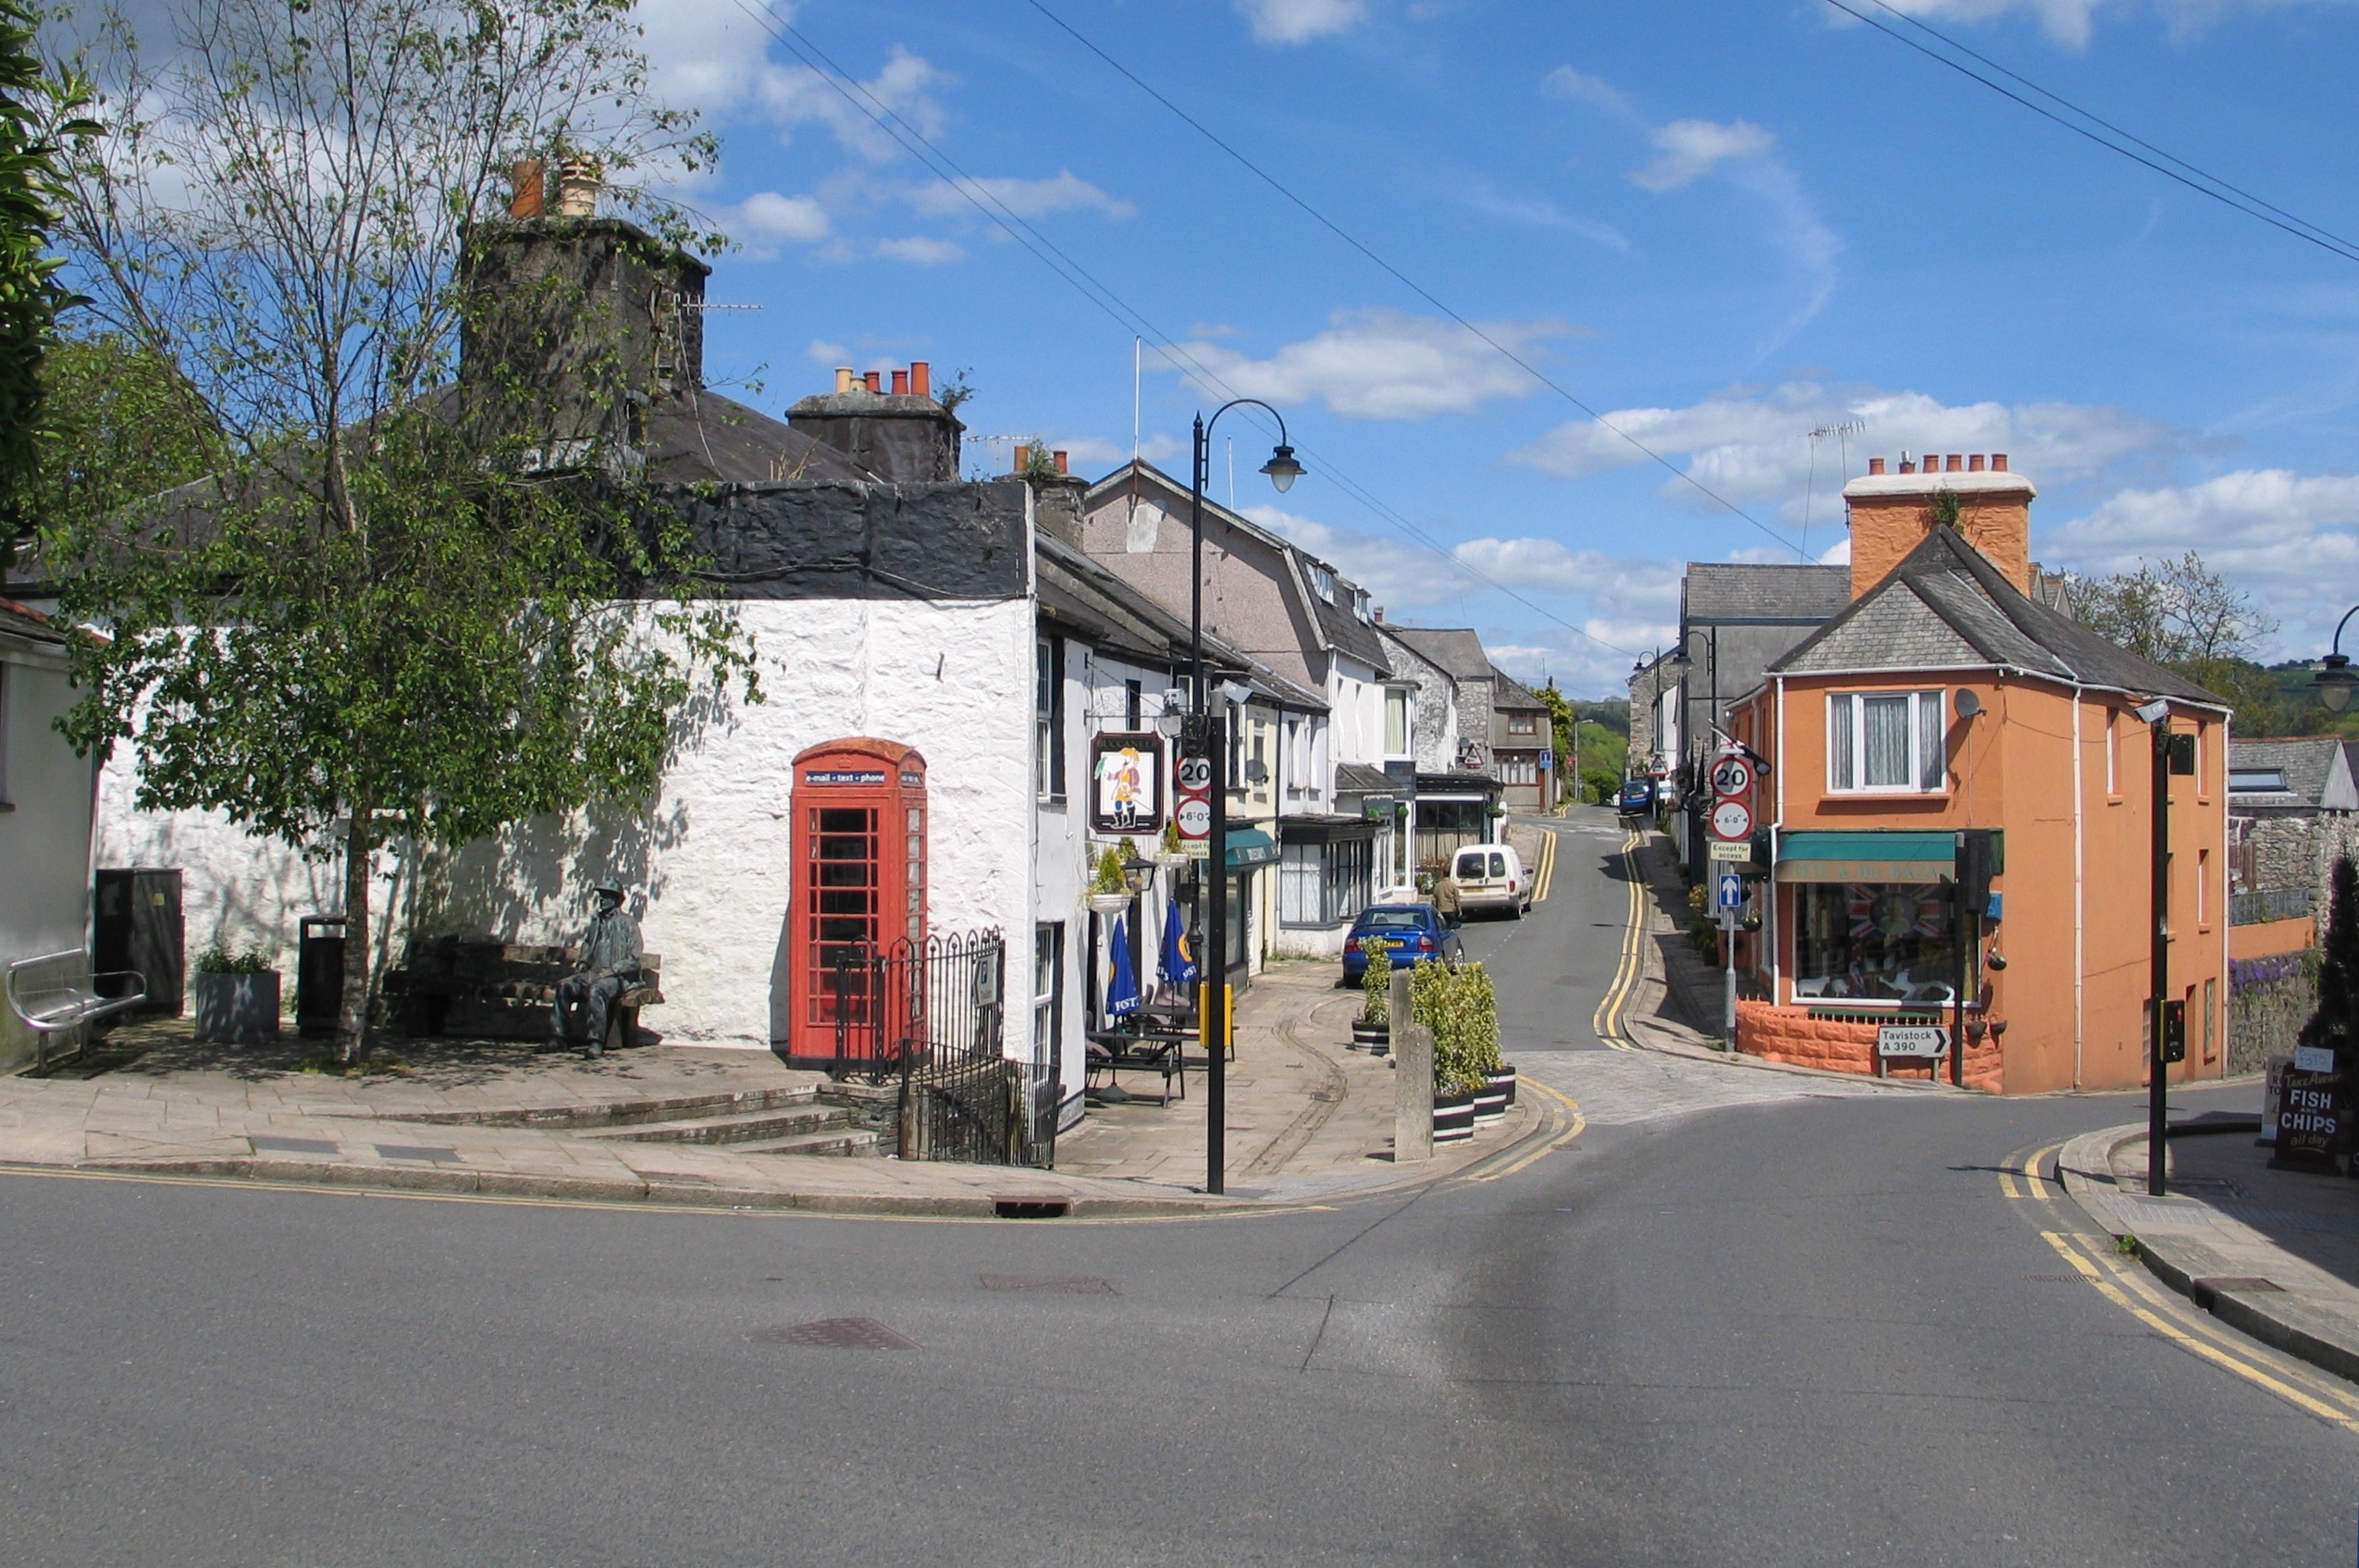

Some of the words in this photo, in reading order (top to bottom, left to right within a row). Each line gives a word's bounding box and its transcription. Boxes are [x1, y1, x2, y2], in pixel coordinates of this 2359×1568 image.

[806, 773, 831, 782] e-mail
[837, 773, 854, 782] text
[860, 773, 885, 783] phone
[1181, 763, 1210, 781] 20
[1716, 769, 1746, 786] 20
[1713, 844, 1736, 852] Except
[1883, 1031, 1932, 1040] Tavistock
[1883, 1043, 1890, 1051] A
[1894, 1042, 1916, 1051] 390
[2290, 1089, 2331, 1109] FISH
[2281, 1112, 2336, 1134] CHIPS
[2290, 1134, 2306, 1146] all
[2308, 1133, 2328, 1148] day
